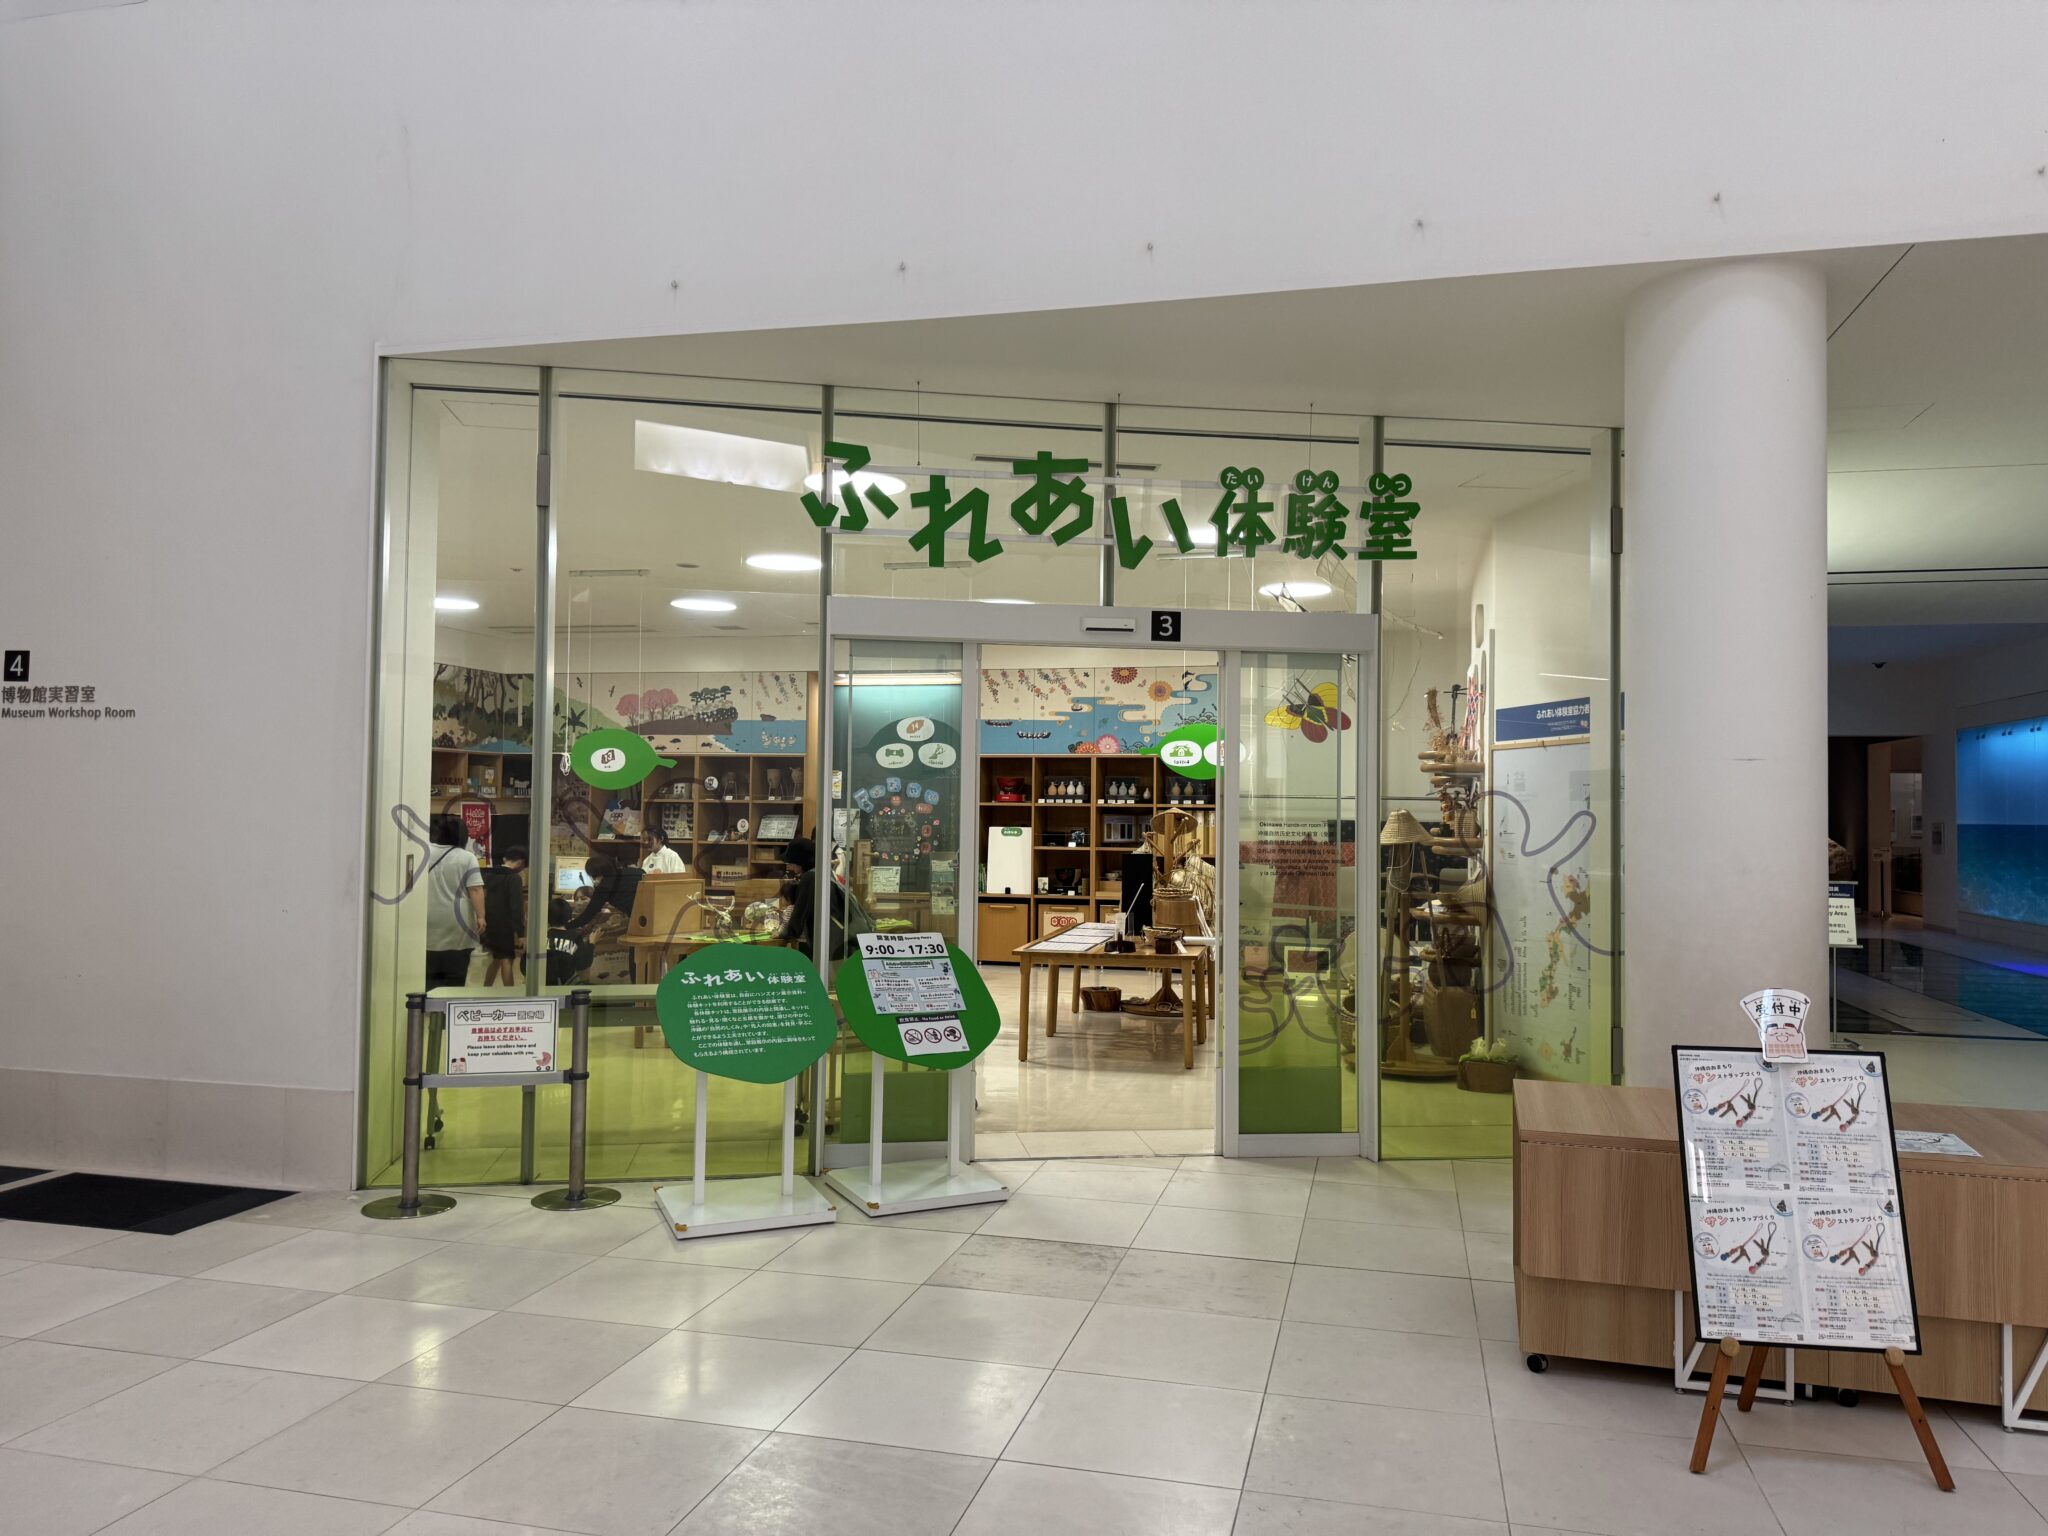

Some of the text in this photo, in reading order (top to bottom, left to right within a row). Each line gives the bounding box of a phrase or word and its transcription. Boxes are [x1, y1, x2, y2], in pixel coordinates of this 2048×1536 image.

[800, 441, 1420, 570] ふれあい体験室
[1159, 616, 1173, 636] 3
[10, 654, 23, 677] 4
[1, 686, 96, 704] 博物館実習室
[1, 707, 136, 720] Museum Workshop Room
[466, 808, 485, 818] Hello
[680, 969, 807, 987] ふれあい体験室
